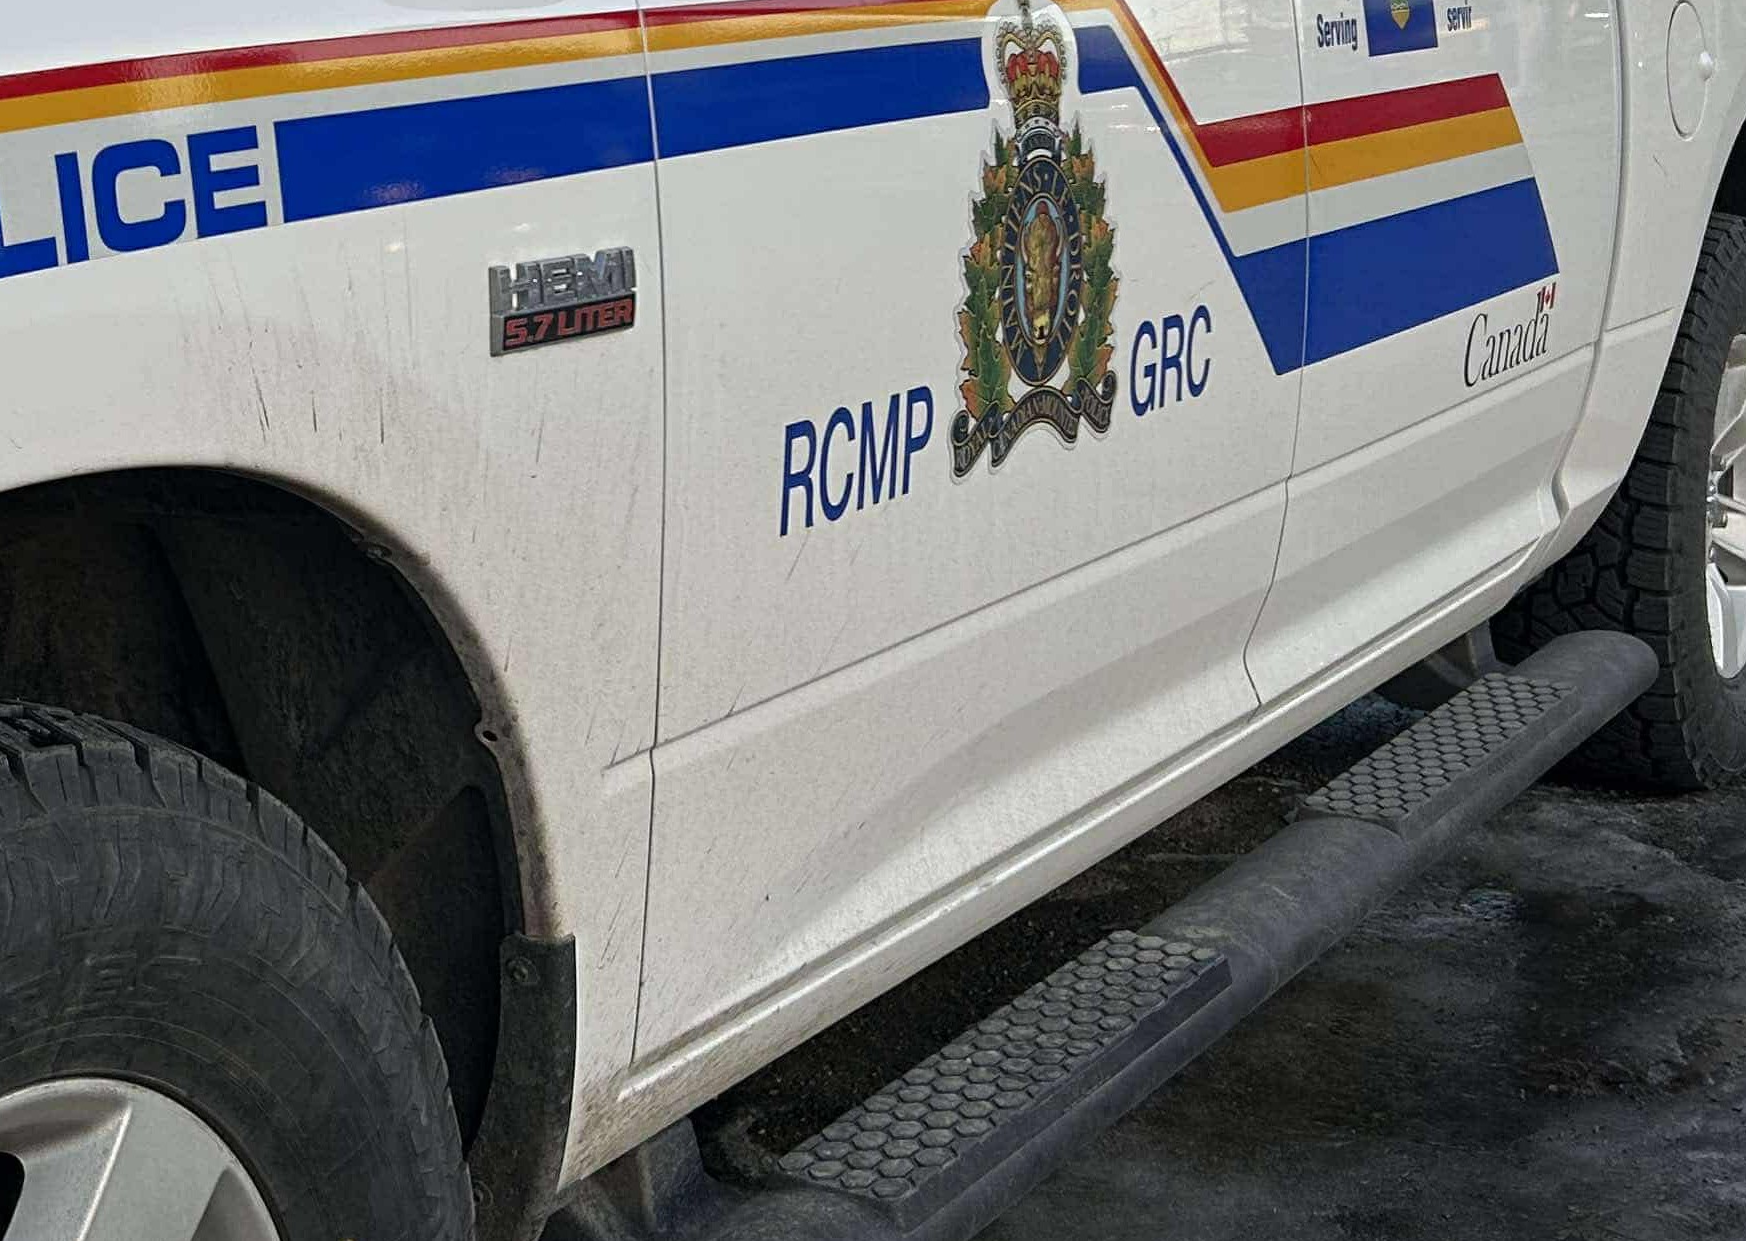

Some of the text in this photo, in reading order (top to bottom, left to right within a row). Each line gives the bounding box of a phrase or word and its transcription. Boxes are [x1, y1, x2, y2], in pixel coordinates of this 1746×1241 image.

[1316, 12, 1358, 51] Serving
[1447, 0, 1472, 32] servir
[489, 246, 636, 313] HEMI
[558, 298, 634, 336] LITER
[1464, 291, 1549, 387] Canada
[1130, 304, 1212, 417] GRC
[780, 385, 934, 538] RCMP
